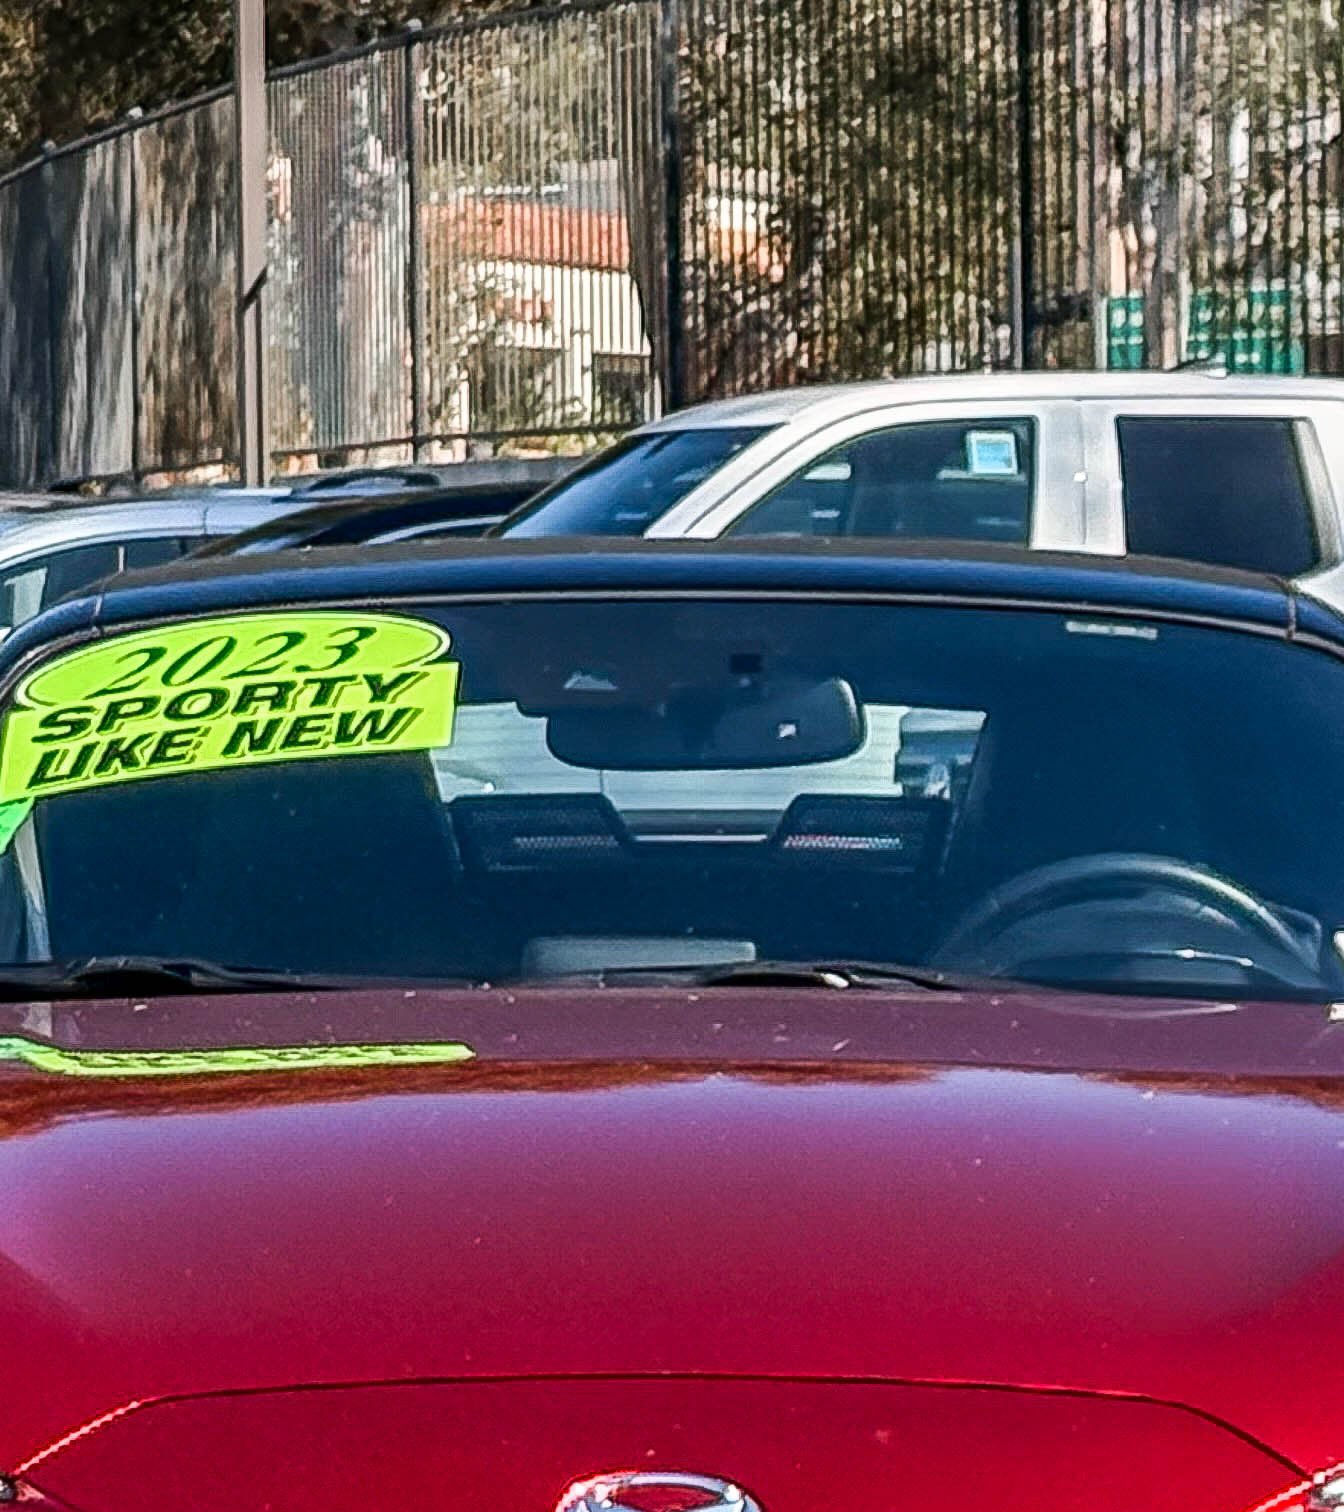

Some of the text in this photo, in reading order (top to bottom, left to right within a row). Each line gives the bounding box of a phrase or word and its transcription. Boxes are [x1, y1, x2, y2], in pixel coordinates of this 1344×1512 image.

[82, 626, 377, 701] 2023
[31, 670, 430, 746] SPORTY
[25, 707, 424, 790] LIKE NEW
